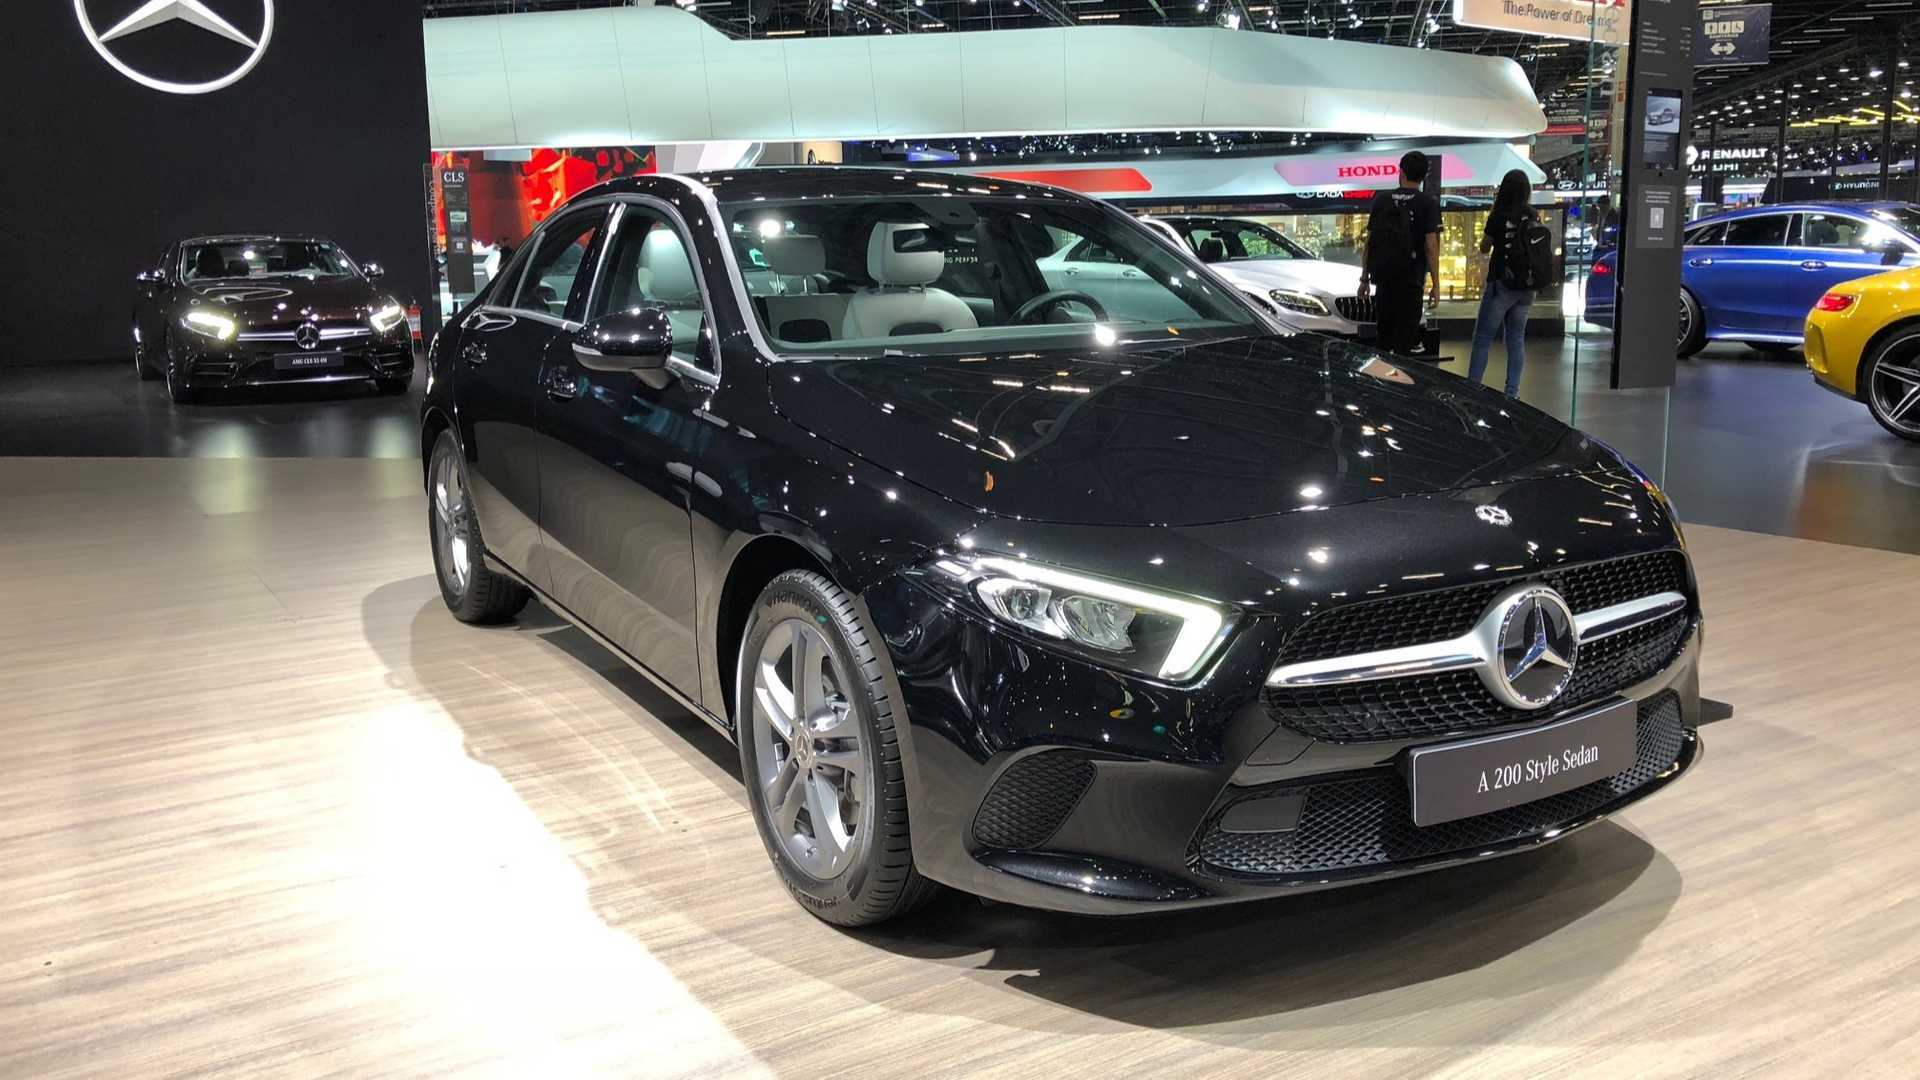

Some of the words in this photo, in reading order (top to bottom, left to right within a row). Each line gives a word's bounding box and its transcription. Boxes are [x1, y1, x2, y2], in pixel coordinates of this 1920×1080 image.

[1503, 1, 1524, 16] The
[1527, 3, 1560, 21] Power
[1562, 10, 1574, 22] of
[1701, 148, 1768, 160] RENAULT
[443, 171, 465, 184] CLS
[1338, 165, 1400, 177] HOND
[1477, 770, 1490, 793] A
[1494, 763, 1522, 789] 200
[1525, 754, 1560, 784] Style
[1562, 744, 1599, 772] Sedan
